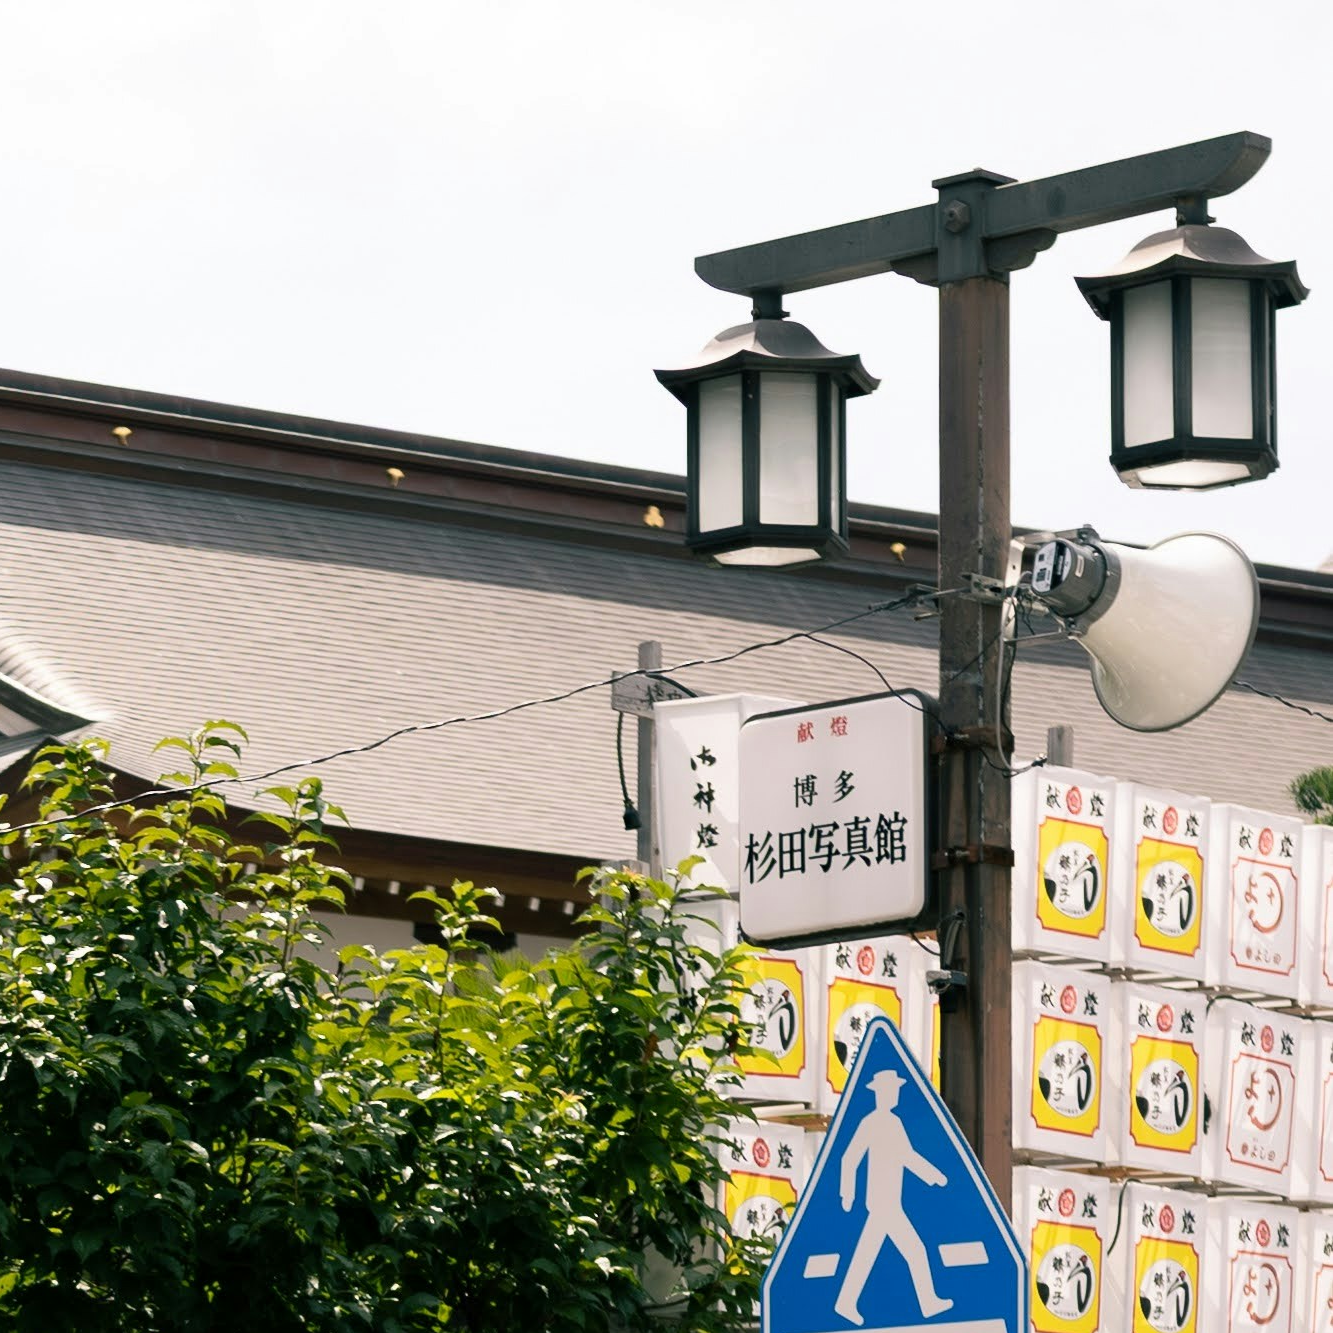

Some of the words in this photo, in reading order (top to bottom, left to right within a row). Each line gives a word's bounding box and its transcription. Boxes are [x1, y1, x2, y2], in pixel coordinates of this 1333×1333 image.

[794, 769, 855, 808] 博多
[744, 811, 908, 884] 杉田写真館
